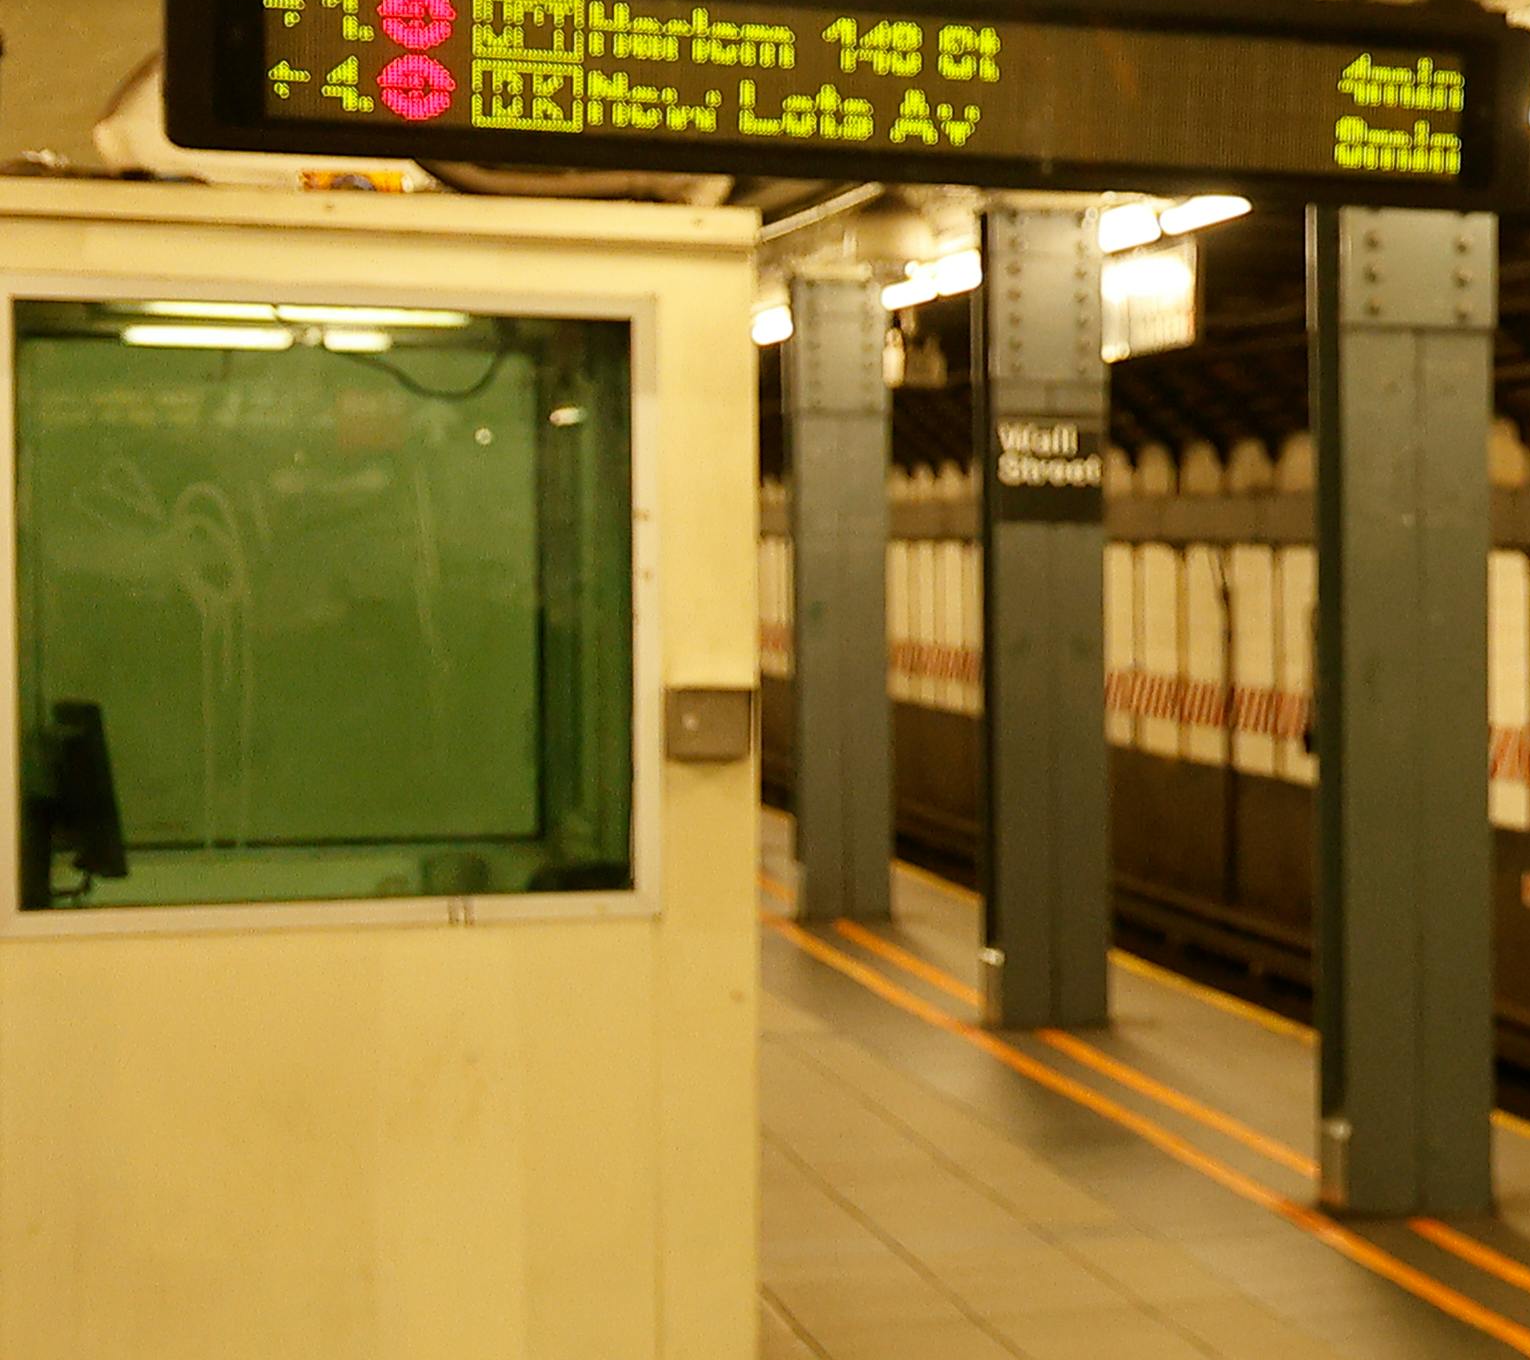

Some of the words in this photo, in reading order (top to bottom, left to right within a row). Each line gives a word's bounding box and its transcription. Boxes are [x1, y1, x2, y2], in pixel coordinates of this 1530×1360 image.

[587, 0, 797, 71] Harlem
[821, 15, 924, 77] 148
[1336, 52, 1466, 113] 4min
[586, 68, 723, 134] New
[738, 78, 875, 142] Lots
[889, 87, 981, 147] Av
[998, 422, 1079, 458] Wall
[998, 452, 1103, 488] Street
